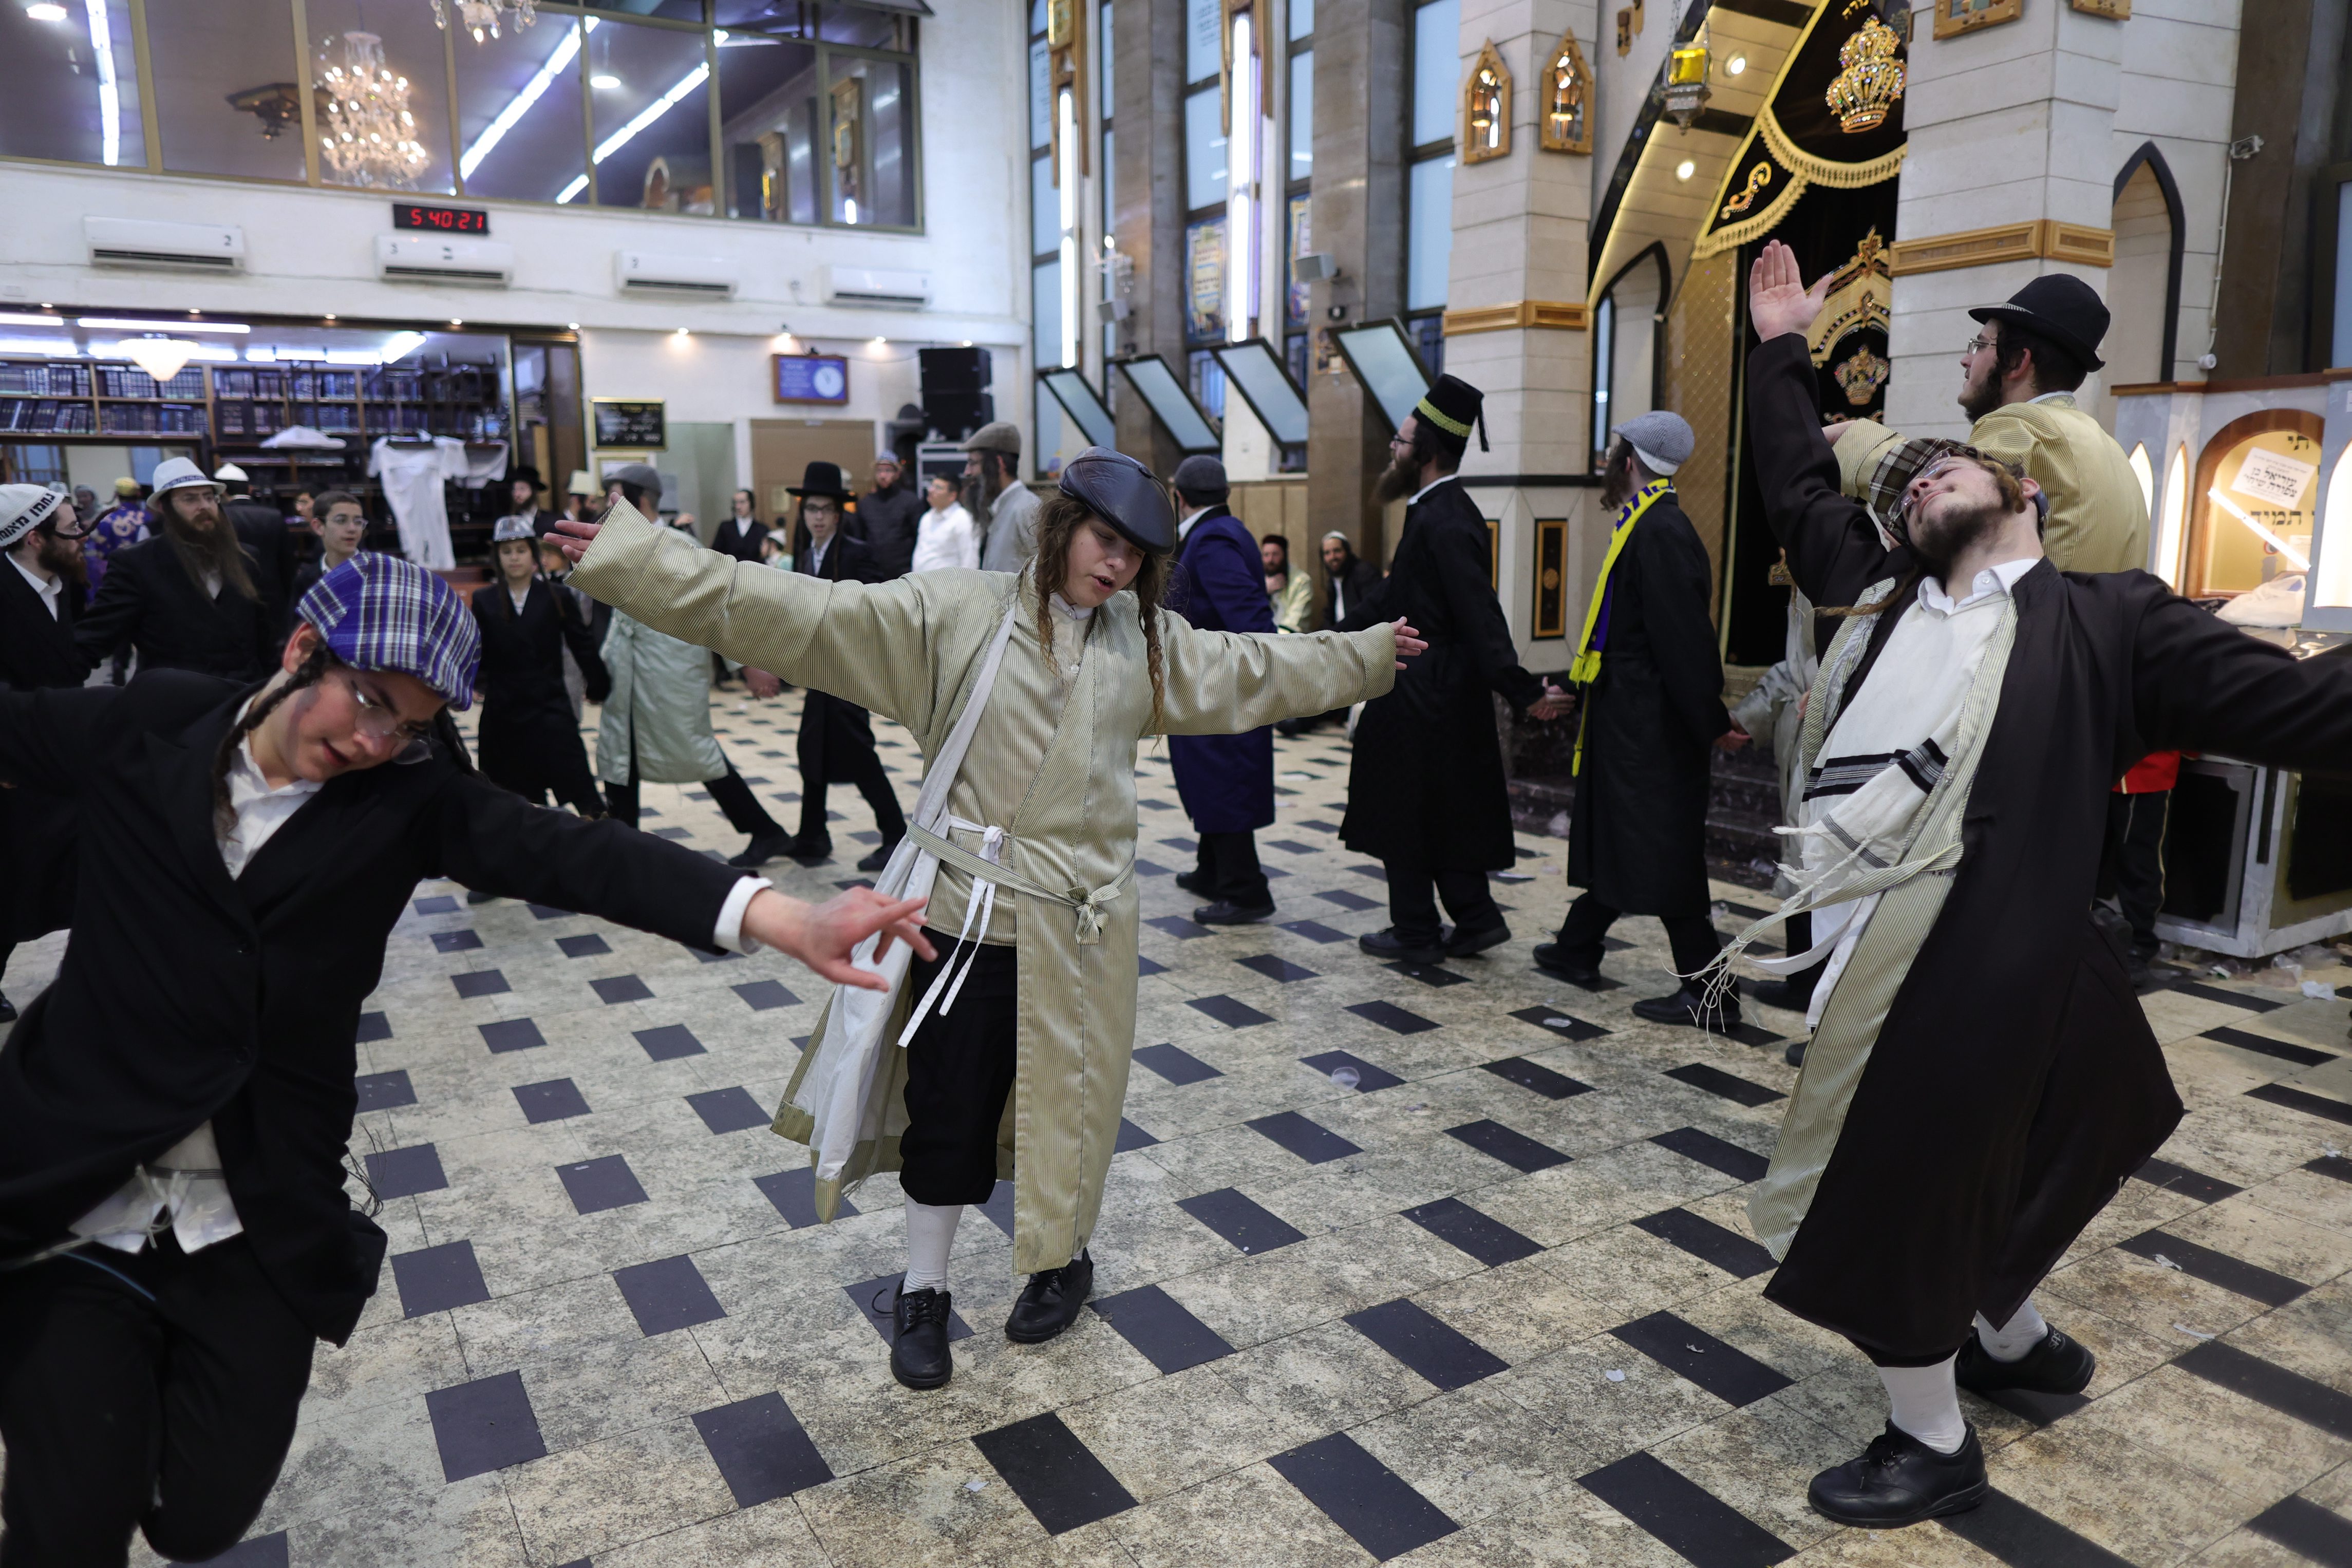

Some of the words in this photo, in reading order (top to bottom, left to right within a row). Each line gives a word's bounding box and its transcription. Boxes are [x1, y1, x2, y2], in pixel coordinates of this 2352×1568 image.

[411, 209, 422, 226] 5
[429, 211, 453, 228] 40
[458, 213, 483, 229] 21
[29, 493, 56, 518] נחמן
[2250, 511, 2302, 526] תמיד
